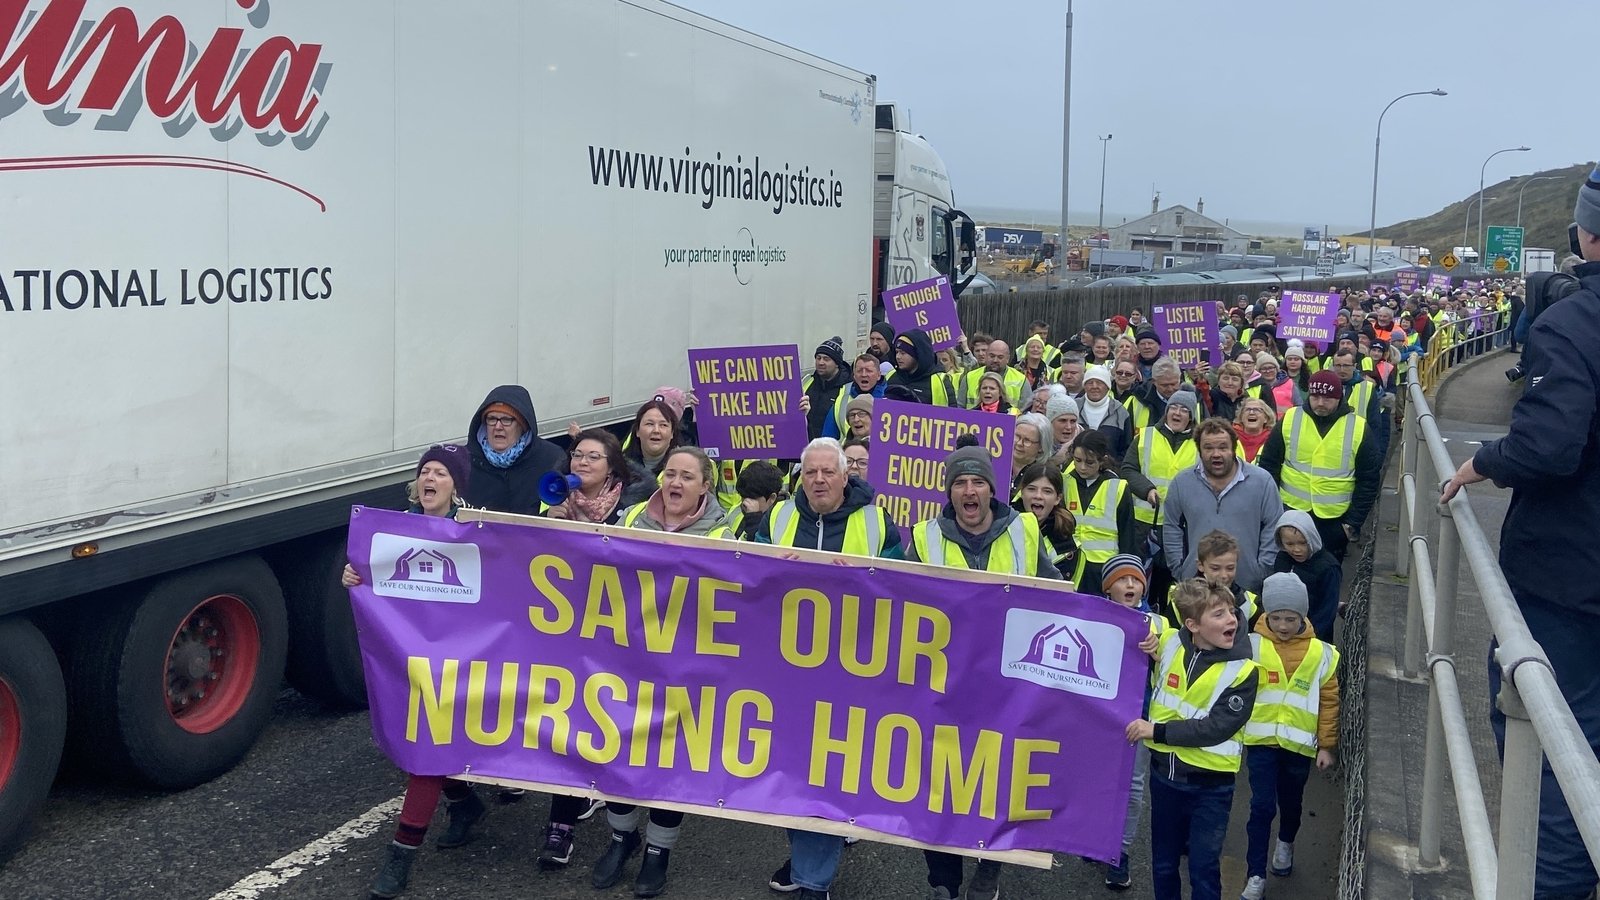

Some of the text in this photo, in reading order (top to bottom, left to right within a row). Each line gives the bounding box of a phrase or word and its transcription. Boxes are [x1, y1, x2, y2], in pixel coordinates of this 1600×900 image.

[588, 145, 843, 214] www.virginialogistics.ie
[1003, 233, 1024, 244] DSV
[664, 245, 786, 268] your partner in green logistics
[180, 266, 332, 305] LOGISTICS
[892, 285, 941, 311] ENOUGH
[1291, 304, 1326, 315] HARBOUR
[1292, 293, 1329, 304] ROSSLARE
[915, 310, 928, 326] IS
[1166, 306, 1204, 324] LISTEN
[1297, 315, 1316, 325] IS AT
[1168, 327, 1206, 344] TO THE
[1283, 326, 1328, 339] SATURATION
[1168, 347, 1208, 364] PEOPL
[696, 356, 793, 384] WE CAN NOT
[709, 390, 787, 417] TAKE ANY
[730, 425, 776, 449] MORE
[879, 412, 892, 442] 3
[985, 426, 1004, 458] IS
[887, 454, 946, 491] ENOUG
[380, 581, 396, 589] SAVE
[398, 582, 414, 591] OUR
[416, 585, 449, 594] NURSING
[528, 554, 951, 694] SAVE OUR
[1008, 662, 1111, 690] SAVE OUR NURSING HOME
[405, 656, 1060, 822] NURSING HOME
